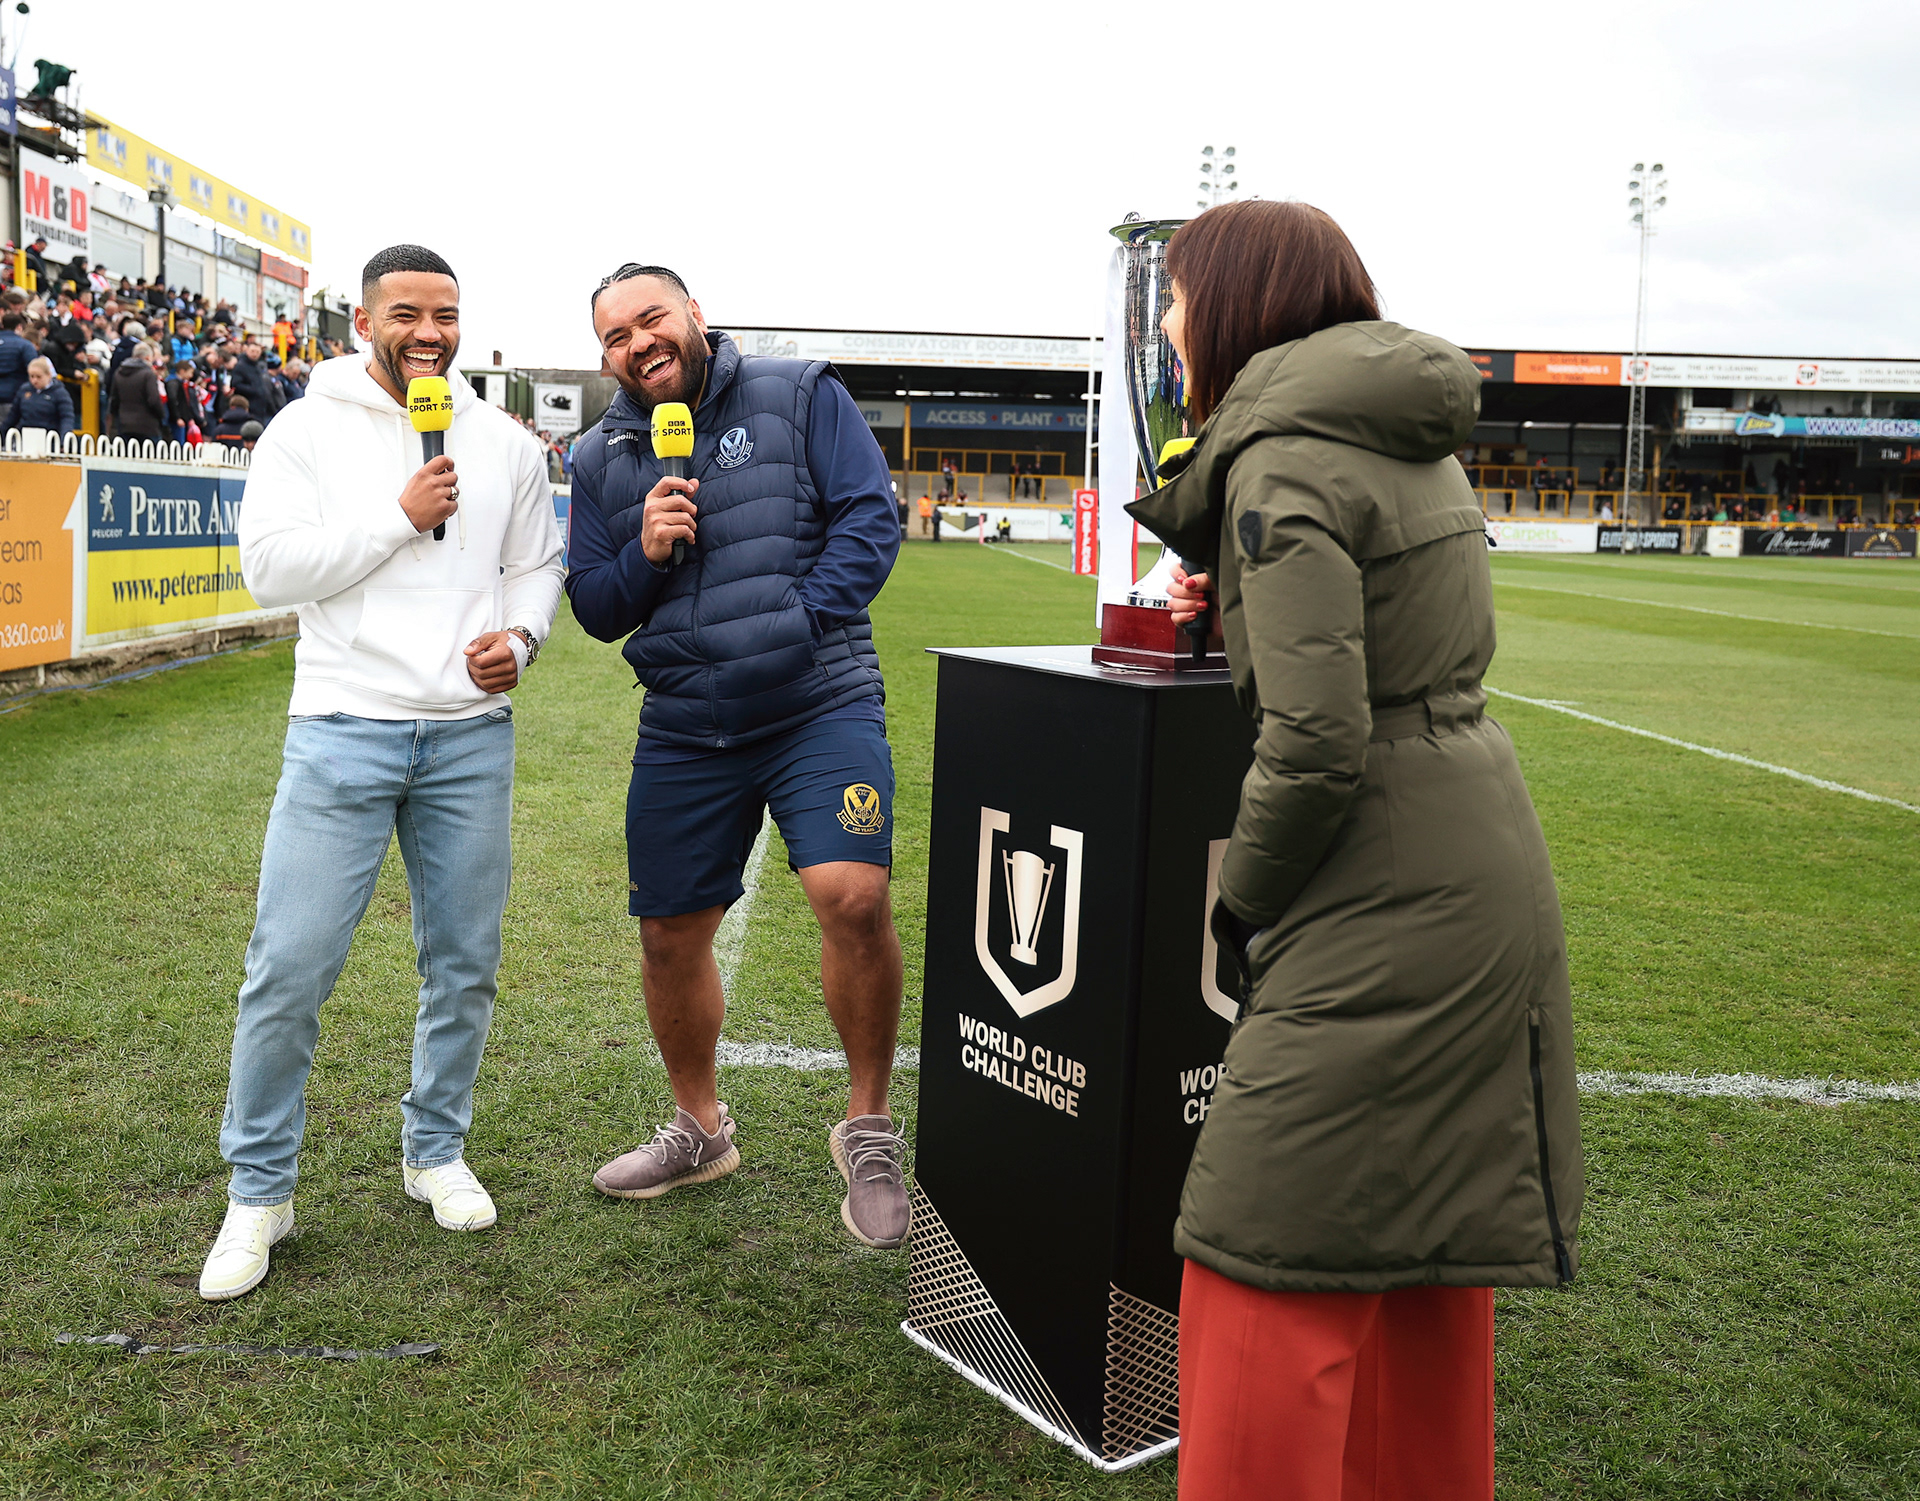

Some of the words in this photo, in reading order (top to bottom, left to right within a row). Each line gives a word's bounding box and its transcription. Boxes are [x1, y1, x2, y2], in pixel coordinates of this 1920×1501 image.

[25, 169, 87, 231] M&D
[25, 218, 88, 250] FOUNDATIONS
[843, 336, 971, 350] CONSERVATORY
[976, 340, 1019, 351] ROOF
[1024, 342, 1079, 354] SWAPS
[409, 404, 438, 413] SPORT
[926, 410, 986, 424] ACCESS
[1002, 411, 1053, 426] PLANT
[662, 428, 691, 436] SPORT
[129, 486, 203, 536] PETER
[206, 490, 242, 535] AM
[92, 528, 123, 538] PEUGEOT
[0, 540, 42, 563] eam
[958, 1013, 1026, 1062] WORLD
[1031, 1045, 1087, 1089] CLUB
[961, 1045, 1080, 1117] CHALLENGE
